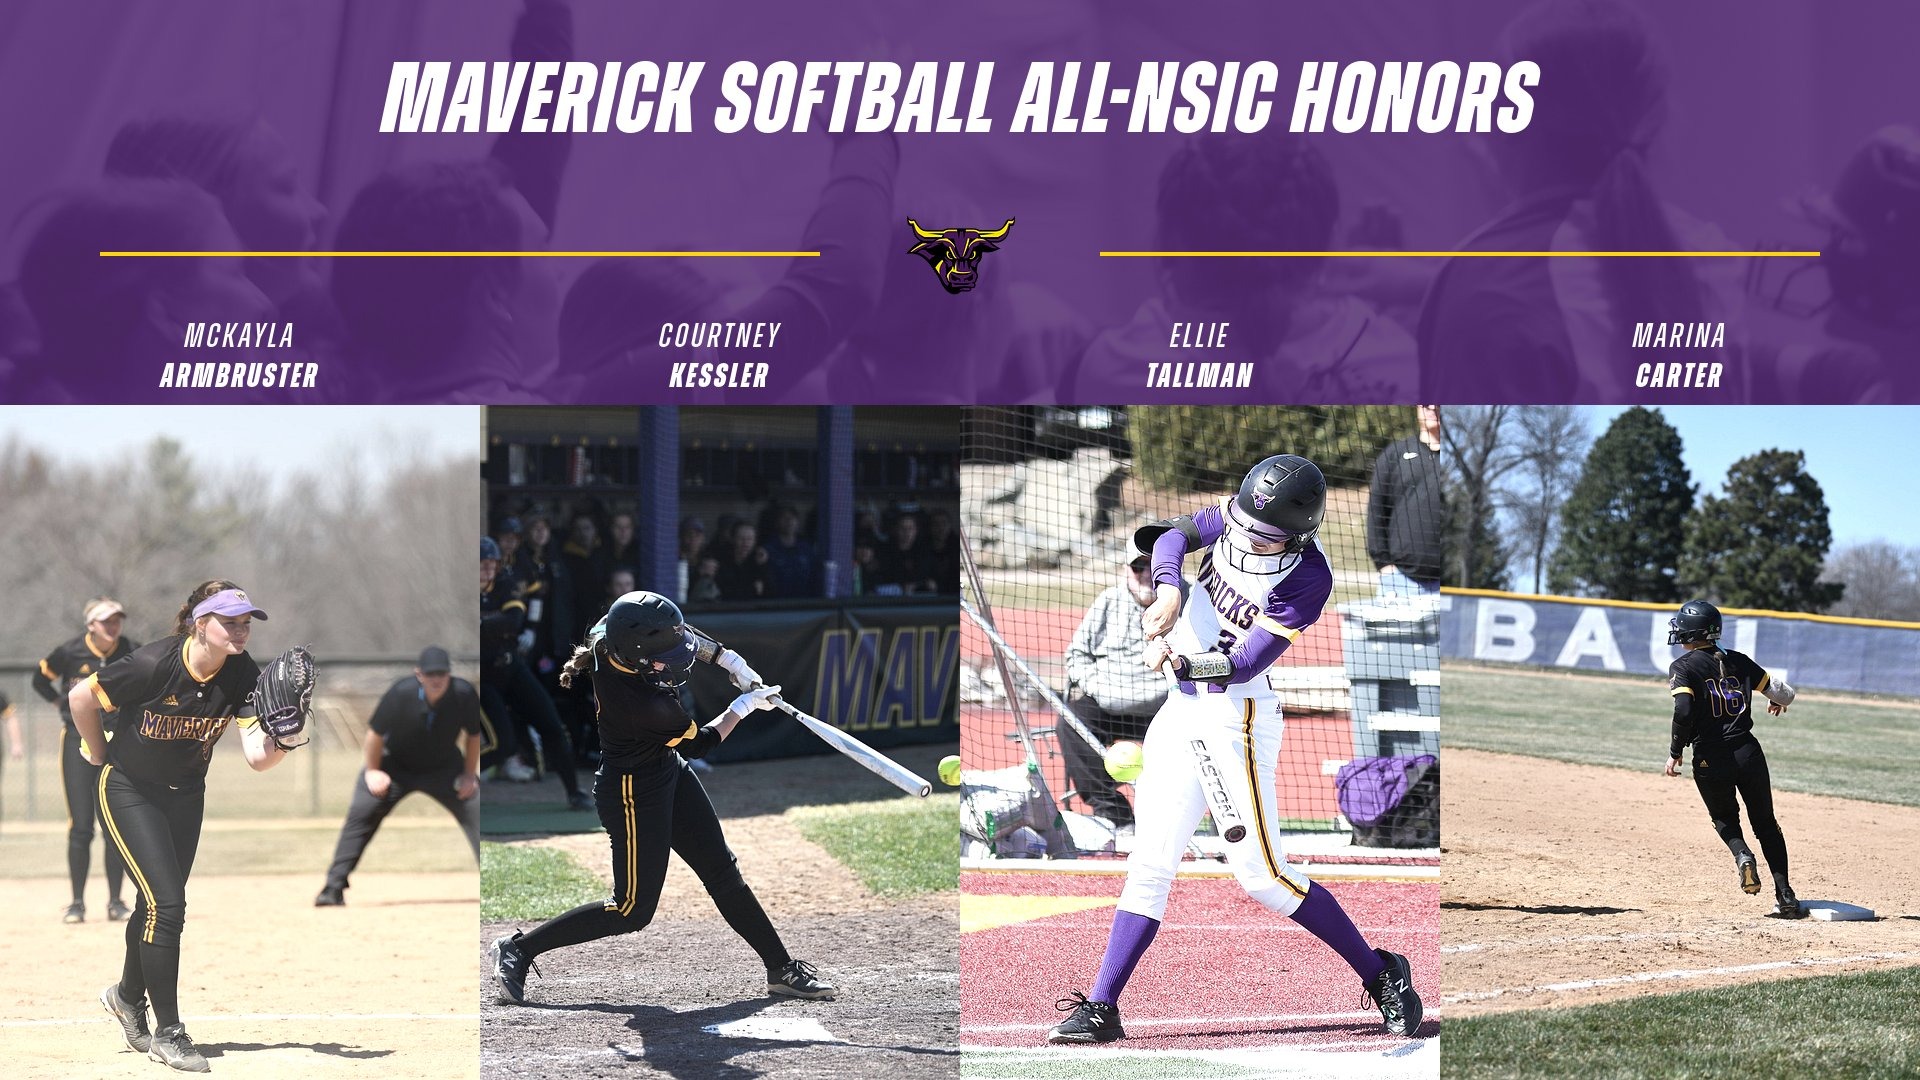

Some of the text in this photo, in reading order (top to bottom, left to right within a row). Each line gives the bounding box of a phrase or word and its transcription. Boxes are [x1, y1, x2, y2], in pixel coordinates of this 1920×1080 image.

[812, 626, 960, 731] MAV
[1704, 675, 1747, 718] 16
[1190, 739, 1236, 819] EASTON
